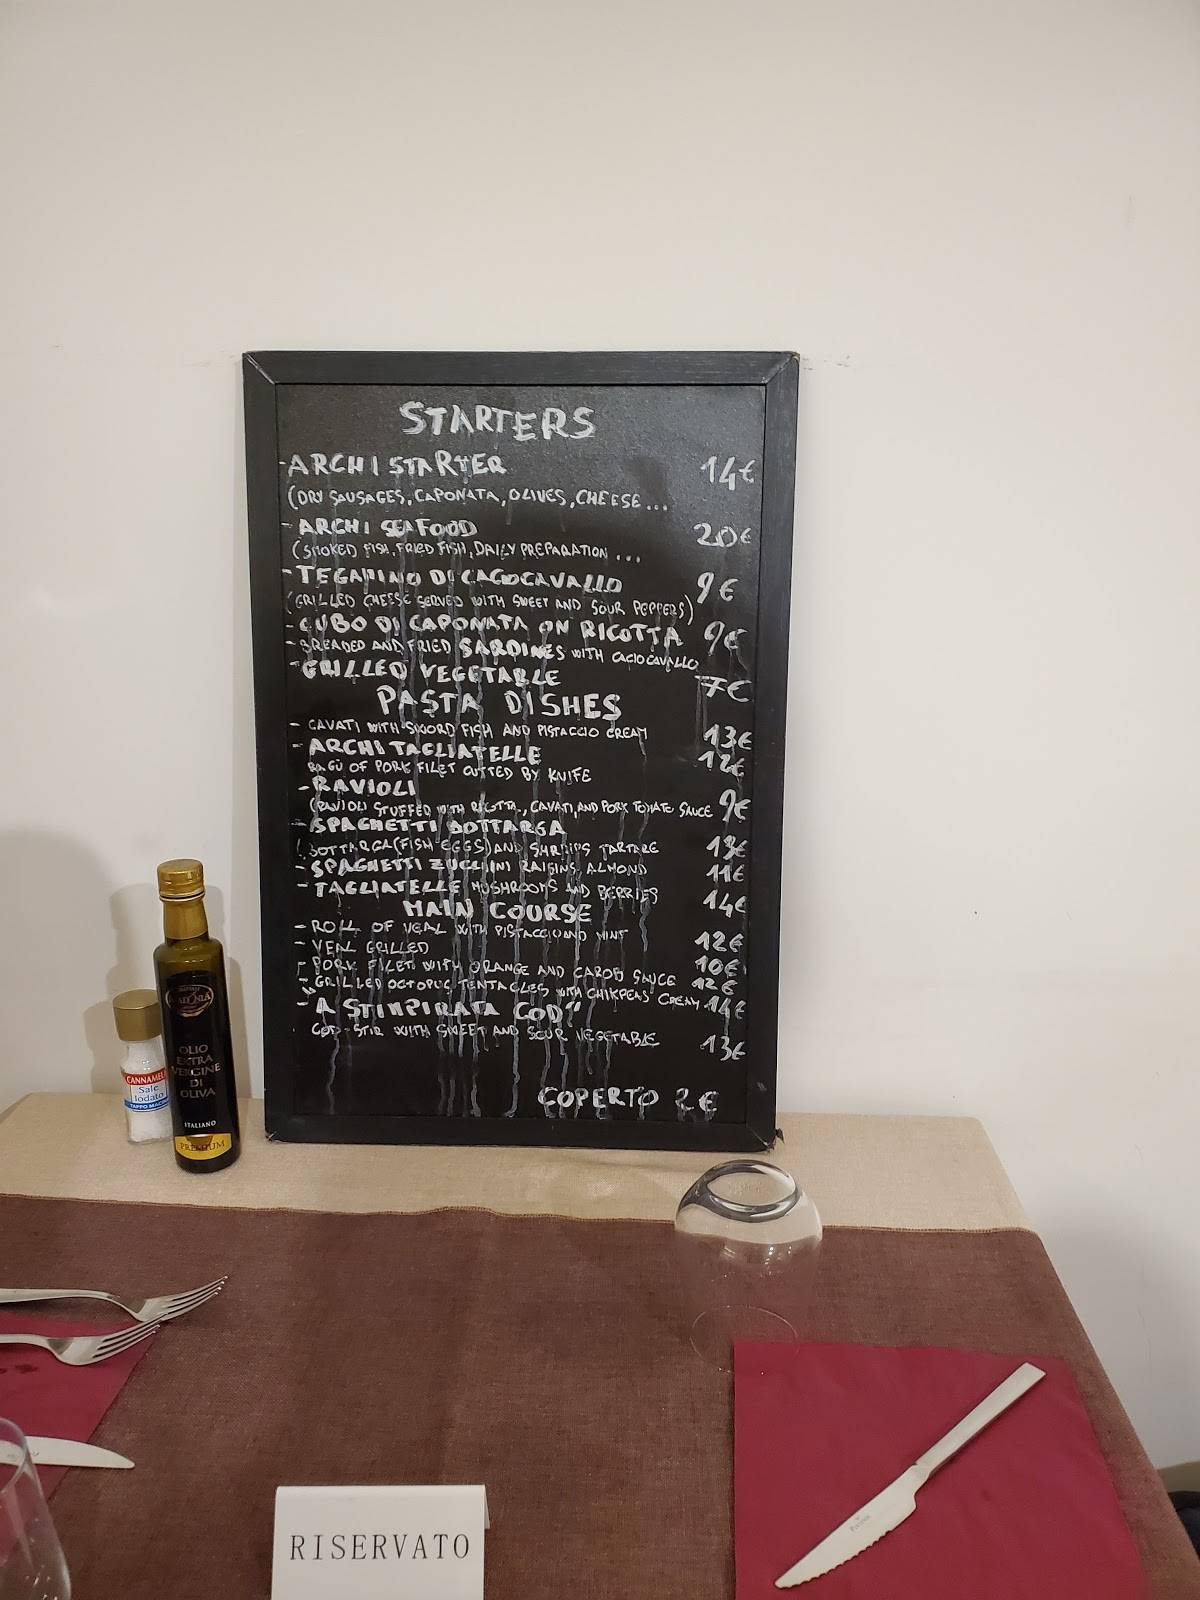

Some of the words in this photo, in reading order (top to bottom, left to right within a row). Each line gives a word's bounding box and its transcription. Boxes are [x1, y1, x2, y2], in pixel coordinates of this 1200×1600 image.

[399, 401, 597, 441] STARTERS
[389, 449, 507, 477] STARTER
[700, 456, 756, 490] 14€
[299, 518, 370, 535] ARCHI
[380, 519, 478, 538] SEAFOOD
[693, 522, 752, 548] 20€
[417, 595, 464, 609] SERVED
[471, 594, 505, 608] WITH
[512, 593, 549, 609] SWEET
[555, 598, 582, 611] AND
[591, 600, 626, 616] SOUR
[299, 613, 368, 634] CUBO
[374, 616, 401, 636] DI
[409, 613, 529, 634] CAPONATA
[538, 619, 570, 635] ON
[580, 619, 684, 649] RICOTTA
[406, 638, 452, 654] FRIED
[459, 636, 565, 661] SARDINES
[571, 649, 604, 664] WITH
[302, 659, 408, 680] GRILLED
[419, 663, 561, 688] VEGETABLE
[694, 674, 752, 702] 7€
[376, 684, 480, 716] PASTA
[504, 690, 622, 721] DISHES
[367, 721, 400, 735] WITH
[461, 723, 494, 739] FISH
[502, 725, 531, 738] AND
[537, 724, 600, 739] PISTACCIO
[703, 723, 752, 750] 13€
[308, 738, 386, 757] ARCHI
[388, 740, 542, 766] TAGLIATELLE
[349, 761, 369, 774] OF
[375, 759, 412, 775] PORK
[522, 767, 540, 783] BY
[549, 767, 592, 785] KNIFE
[698, 750, 745, 778] 12€
[312, 775, 416, 797] RAVIOLI
[373, 801, 432, 817] STUFFED
[601, 800, 629, 814] PORK
[679, 801, 714, 819] SAUCE
[309, 816, 438, 834] SPAGHETTI
[446, 819, 567, 837] BOTTARGA
[310, 857, 423, 878] SPAGHETTI
[586, 863, 648, 876] ALMOND
[705, 863, 745, 883] 11€
[314, 878, 462, 898] TAGLIATELLE
[597, 884, 659, 905] BERRIES
[402, 898, 474, 919] MAIN
[489, 901, 593, 924] COURSE
[702, 889, 747, 918] 14€
[371, 919, 395, 934] OF
[403, 921, 447, 936] VEAL
[366, 940, 430, 956] GRILLED
[694, 930, 745, 953] 12€
[469, 959, 530, 976] ORANGE
[537, 964, 565, 979] AND
[632, 969, 677, 987] SAUCE
[694, 954, 741, 978] 10€
[314, 975, 382, 991] GRILLED
[393, 1024, 431, 1039] WITH
[493, 1025, 519, 1037] AND
[526, 1025, 568, 1042] SOUR
[179, 1044, 209, 1055] OLIO
[699, 1034, 747, 1061] 13€
[171, 1062, 222, 1078] VERGINE
[176, 1055, 214, 1066] EXTRA
[138, 1085, 160, 1094] Sale
[180, 1088, 216, 1099] OLIVA
[190, 1078, 204, 1088] DI
[538, 1086, 660, 1109] COPERTO
[184, 1120, 217, 1129] ITALIANO
[290, 1533, 470, 1560] RISERVATO
